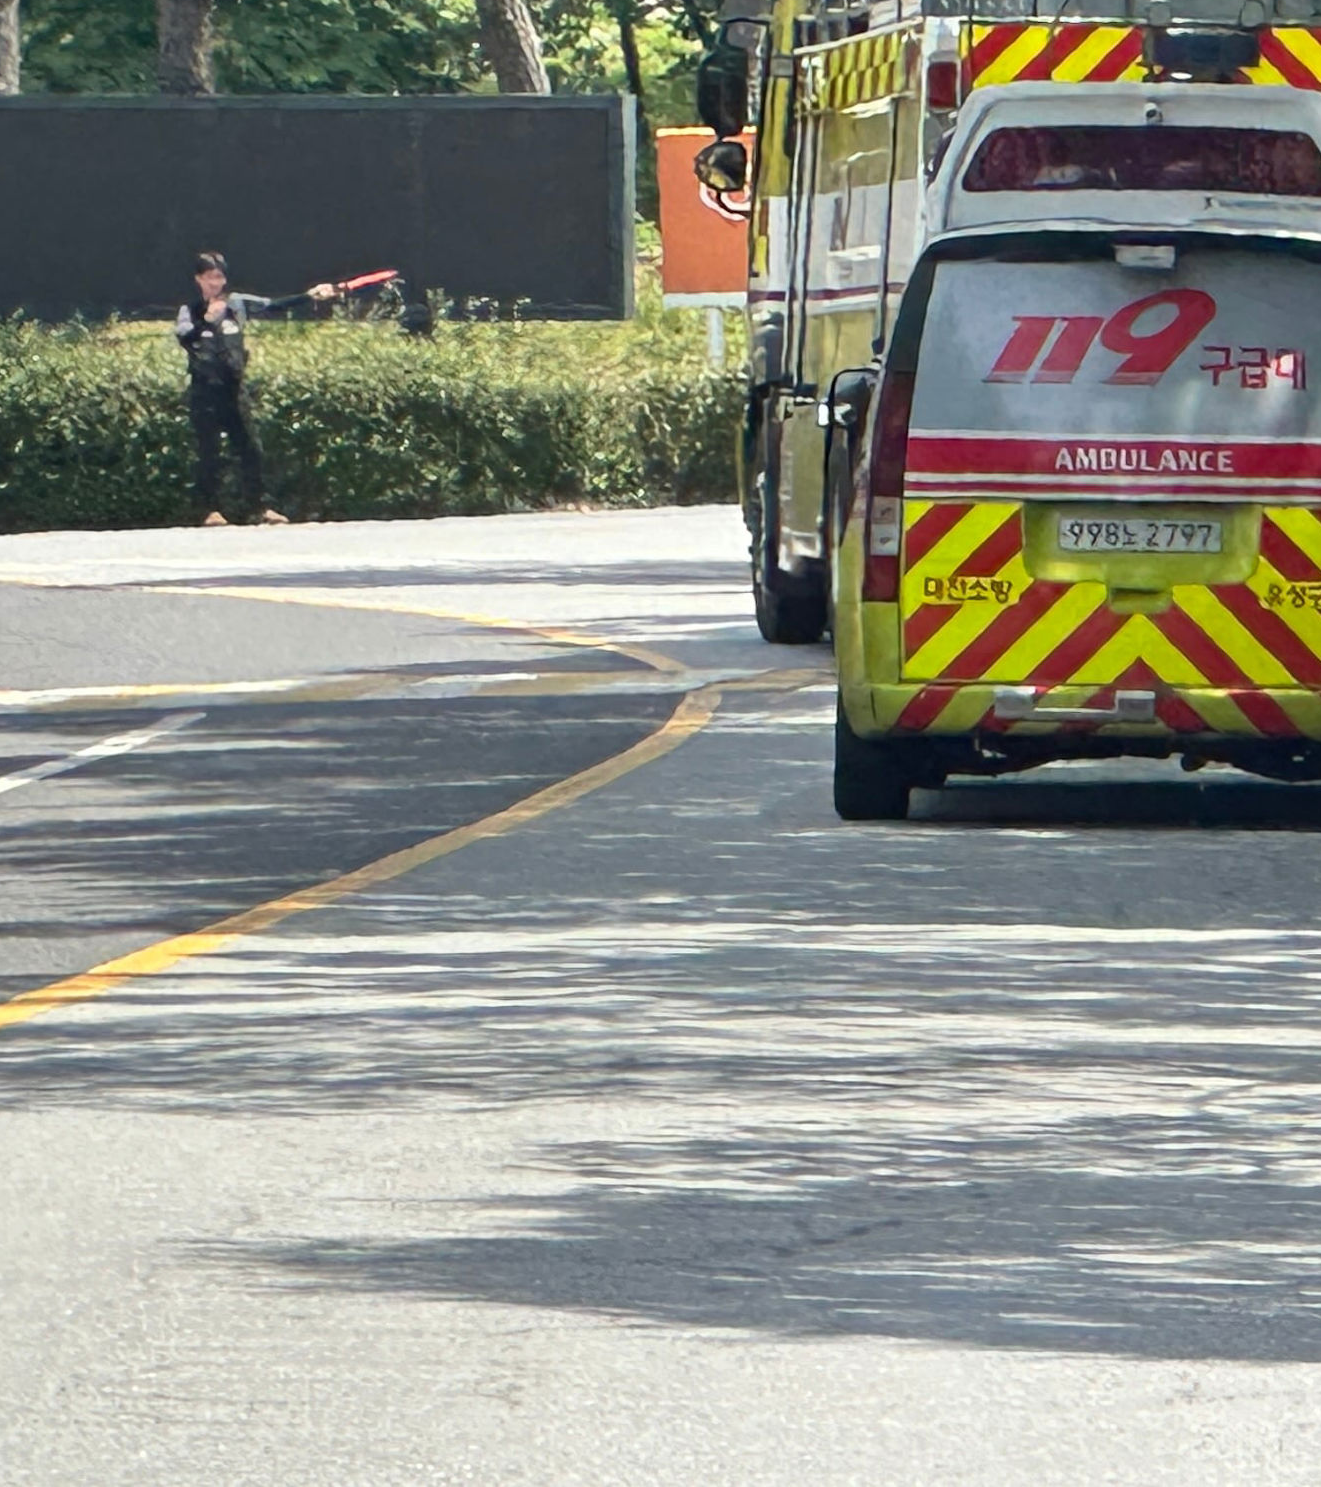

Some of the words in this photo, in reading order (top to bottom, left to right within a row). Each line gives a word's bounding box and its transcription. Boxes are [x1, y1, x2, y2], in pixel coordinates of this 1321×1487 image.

[981, 288, 1217, 386] 119
[1198, 346, 1308, 390] 구급대
[1054, 447, 1235, 473] AMBULANCE
